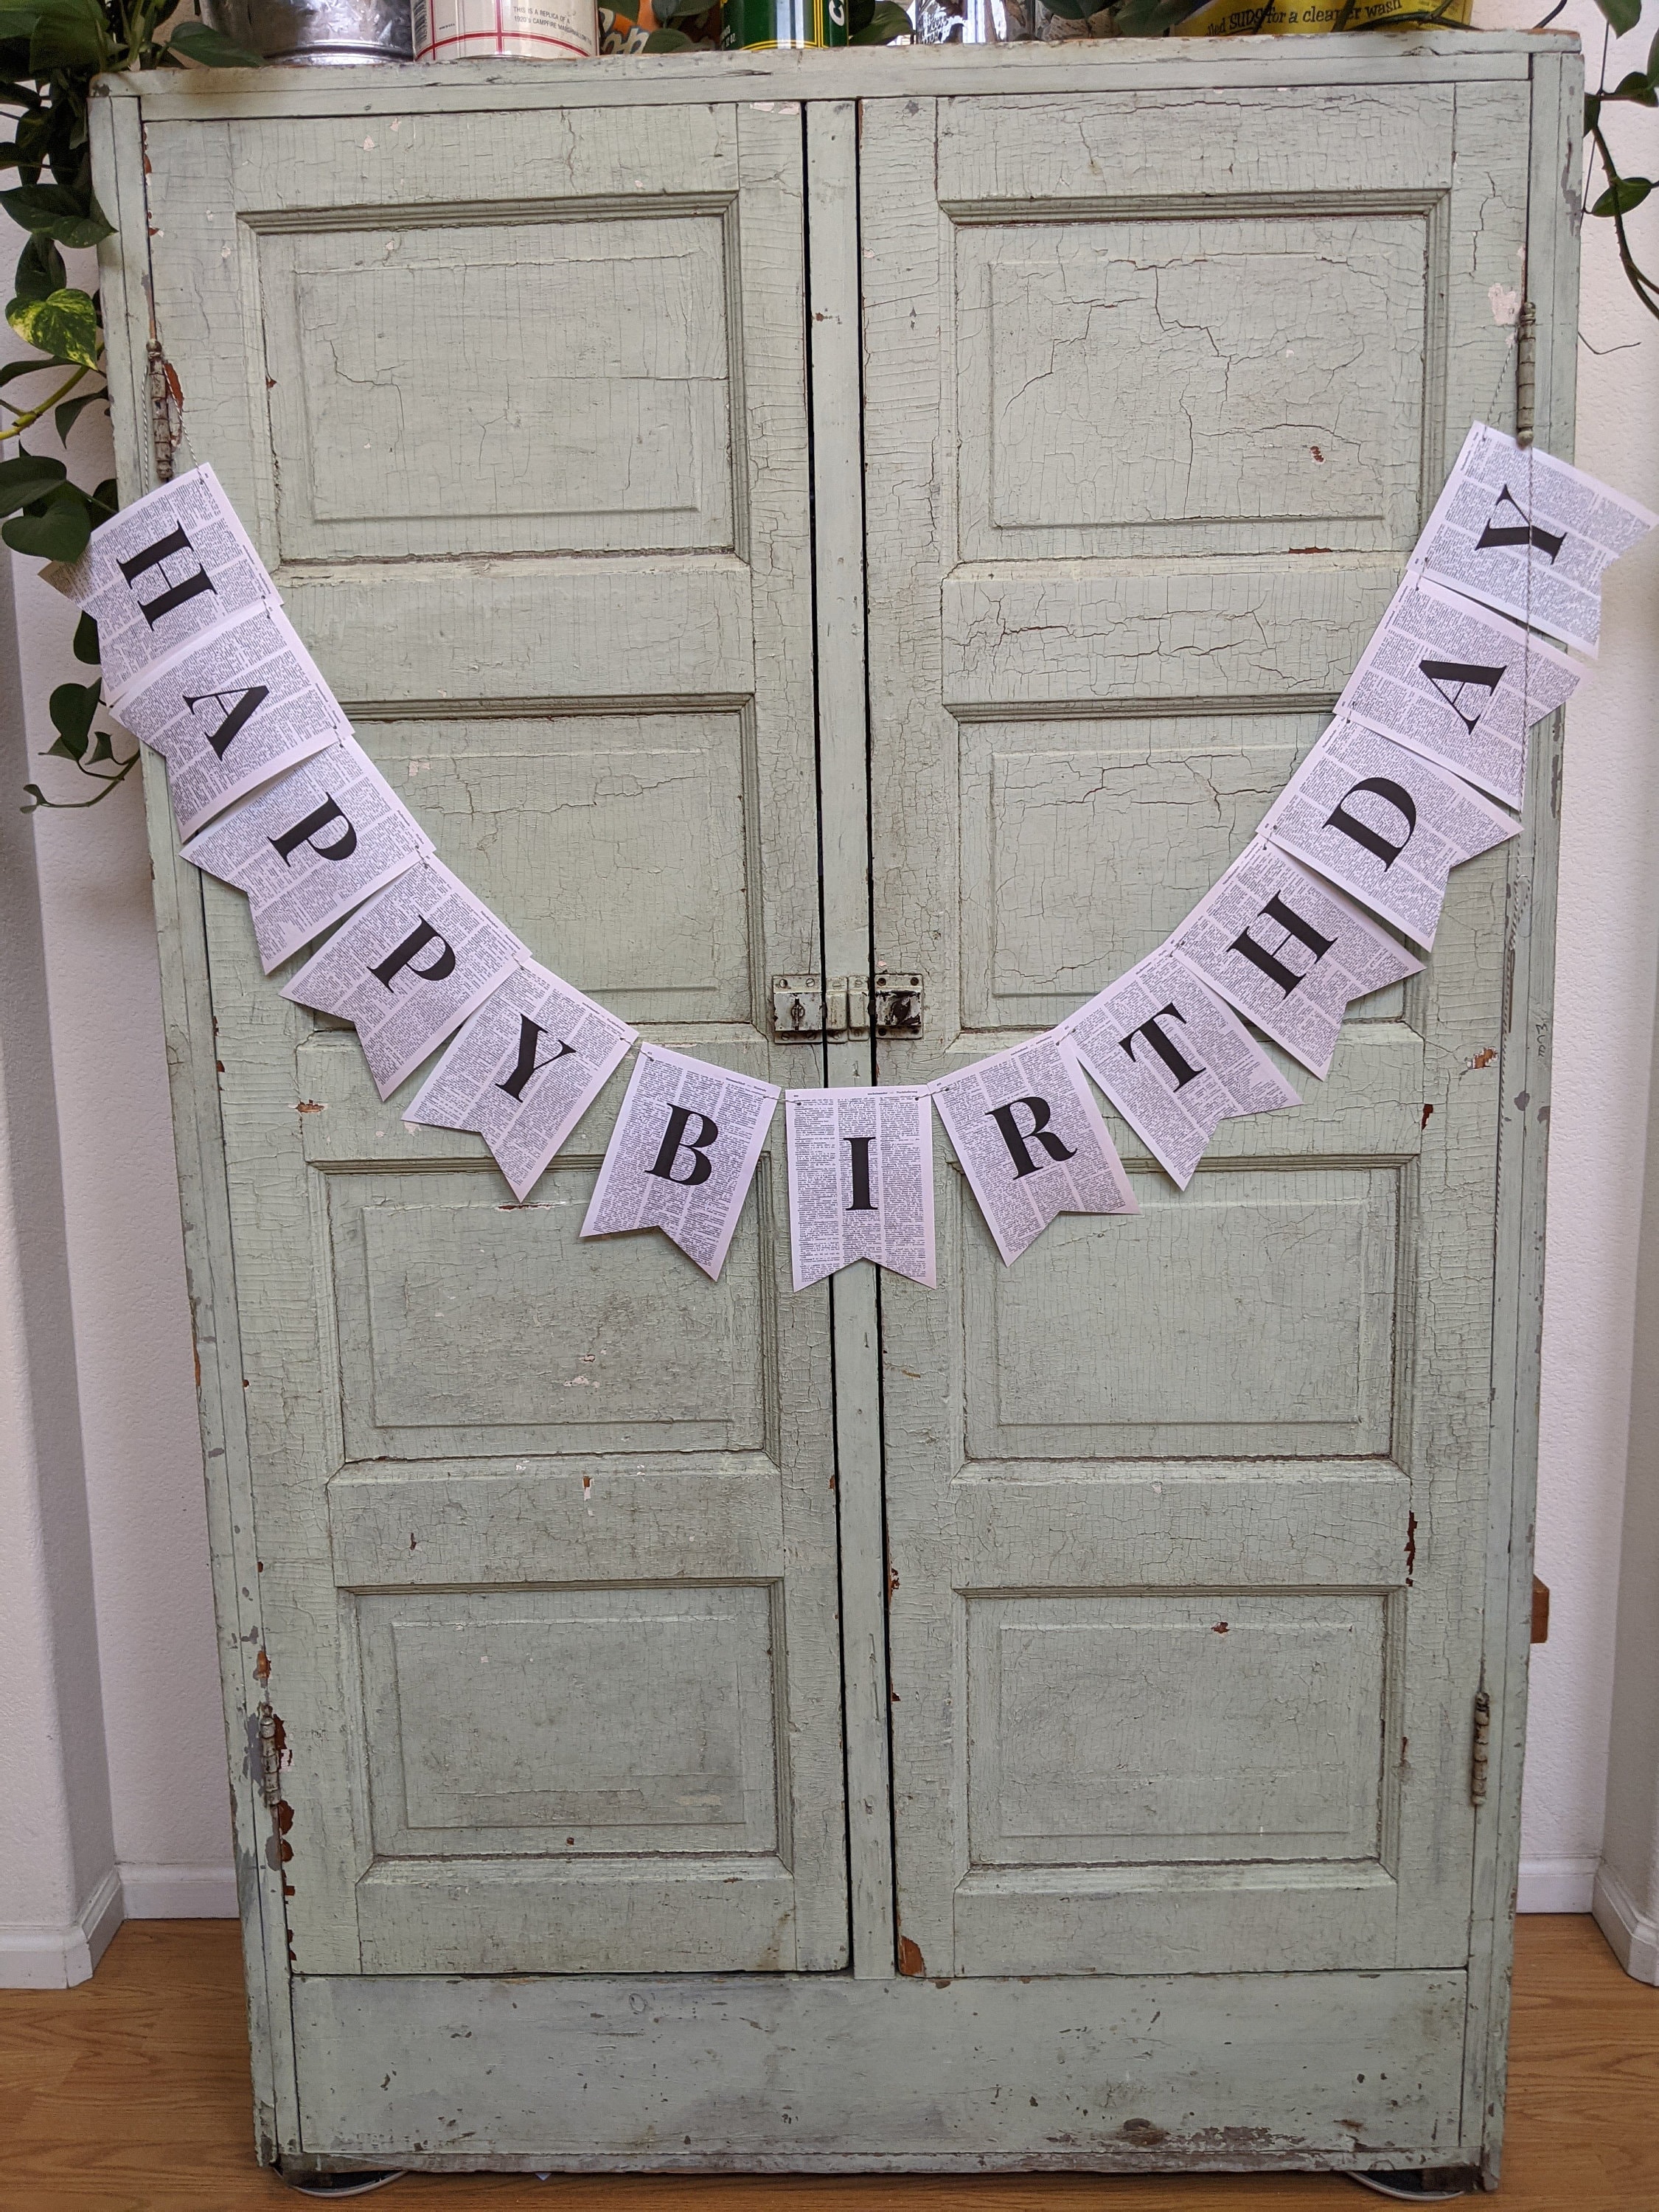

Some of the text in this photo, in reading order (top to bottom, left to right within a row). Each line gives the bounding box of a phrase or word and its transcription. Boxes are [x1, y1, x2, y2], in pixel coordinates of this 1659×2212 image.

[532, 17, 557, 29] CAMPFIRE
[540, 10, 559, 21] REPLICA
[1266, 7, 1287, 24] for
[1289, 12, 1298, 24] a
[1366, 0, 1402, 18] wash
[116, 521, 577, 1103] HAPPY
[644, 484, 1568, 1211] BIRTHDAY
